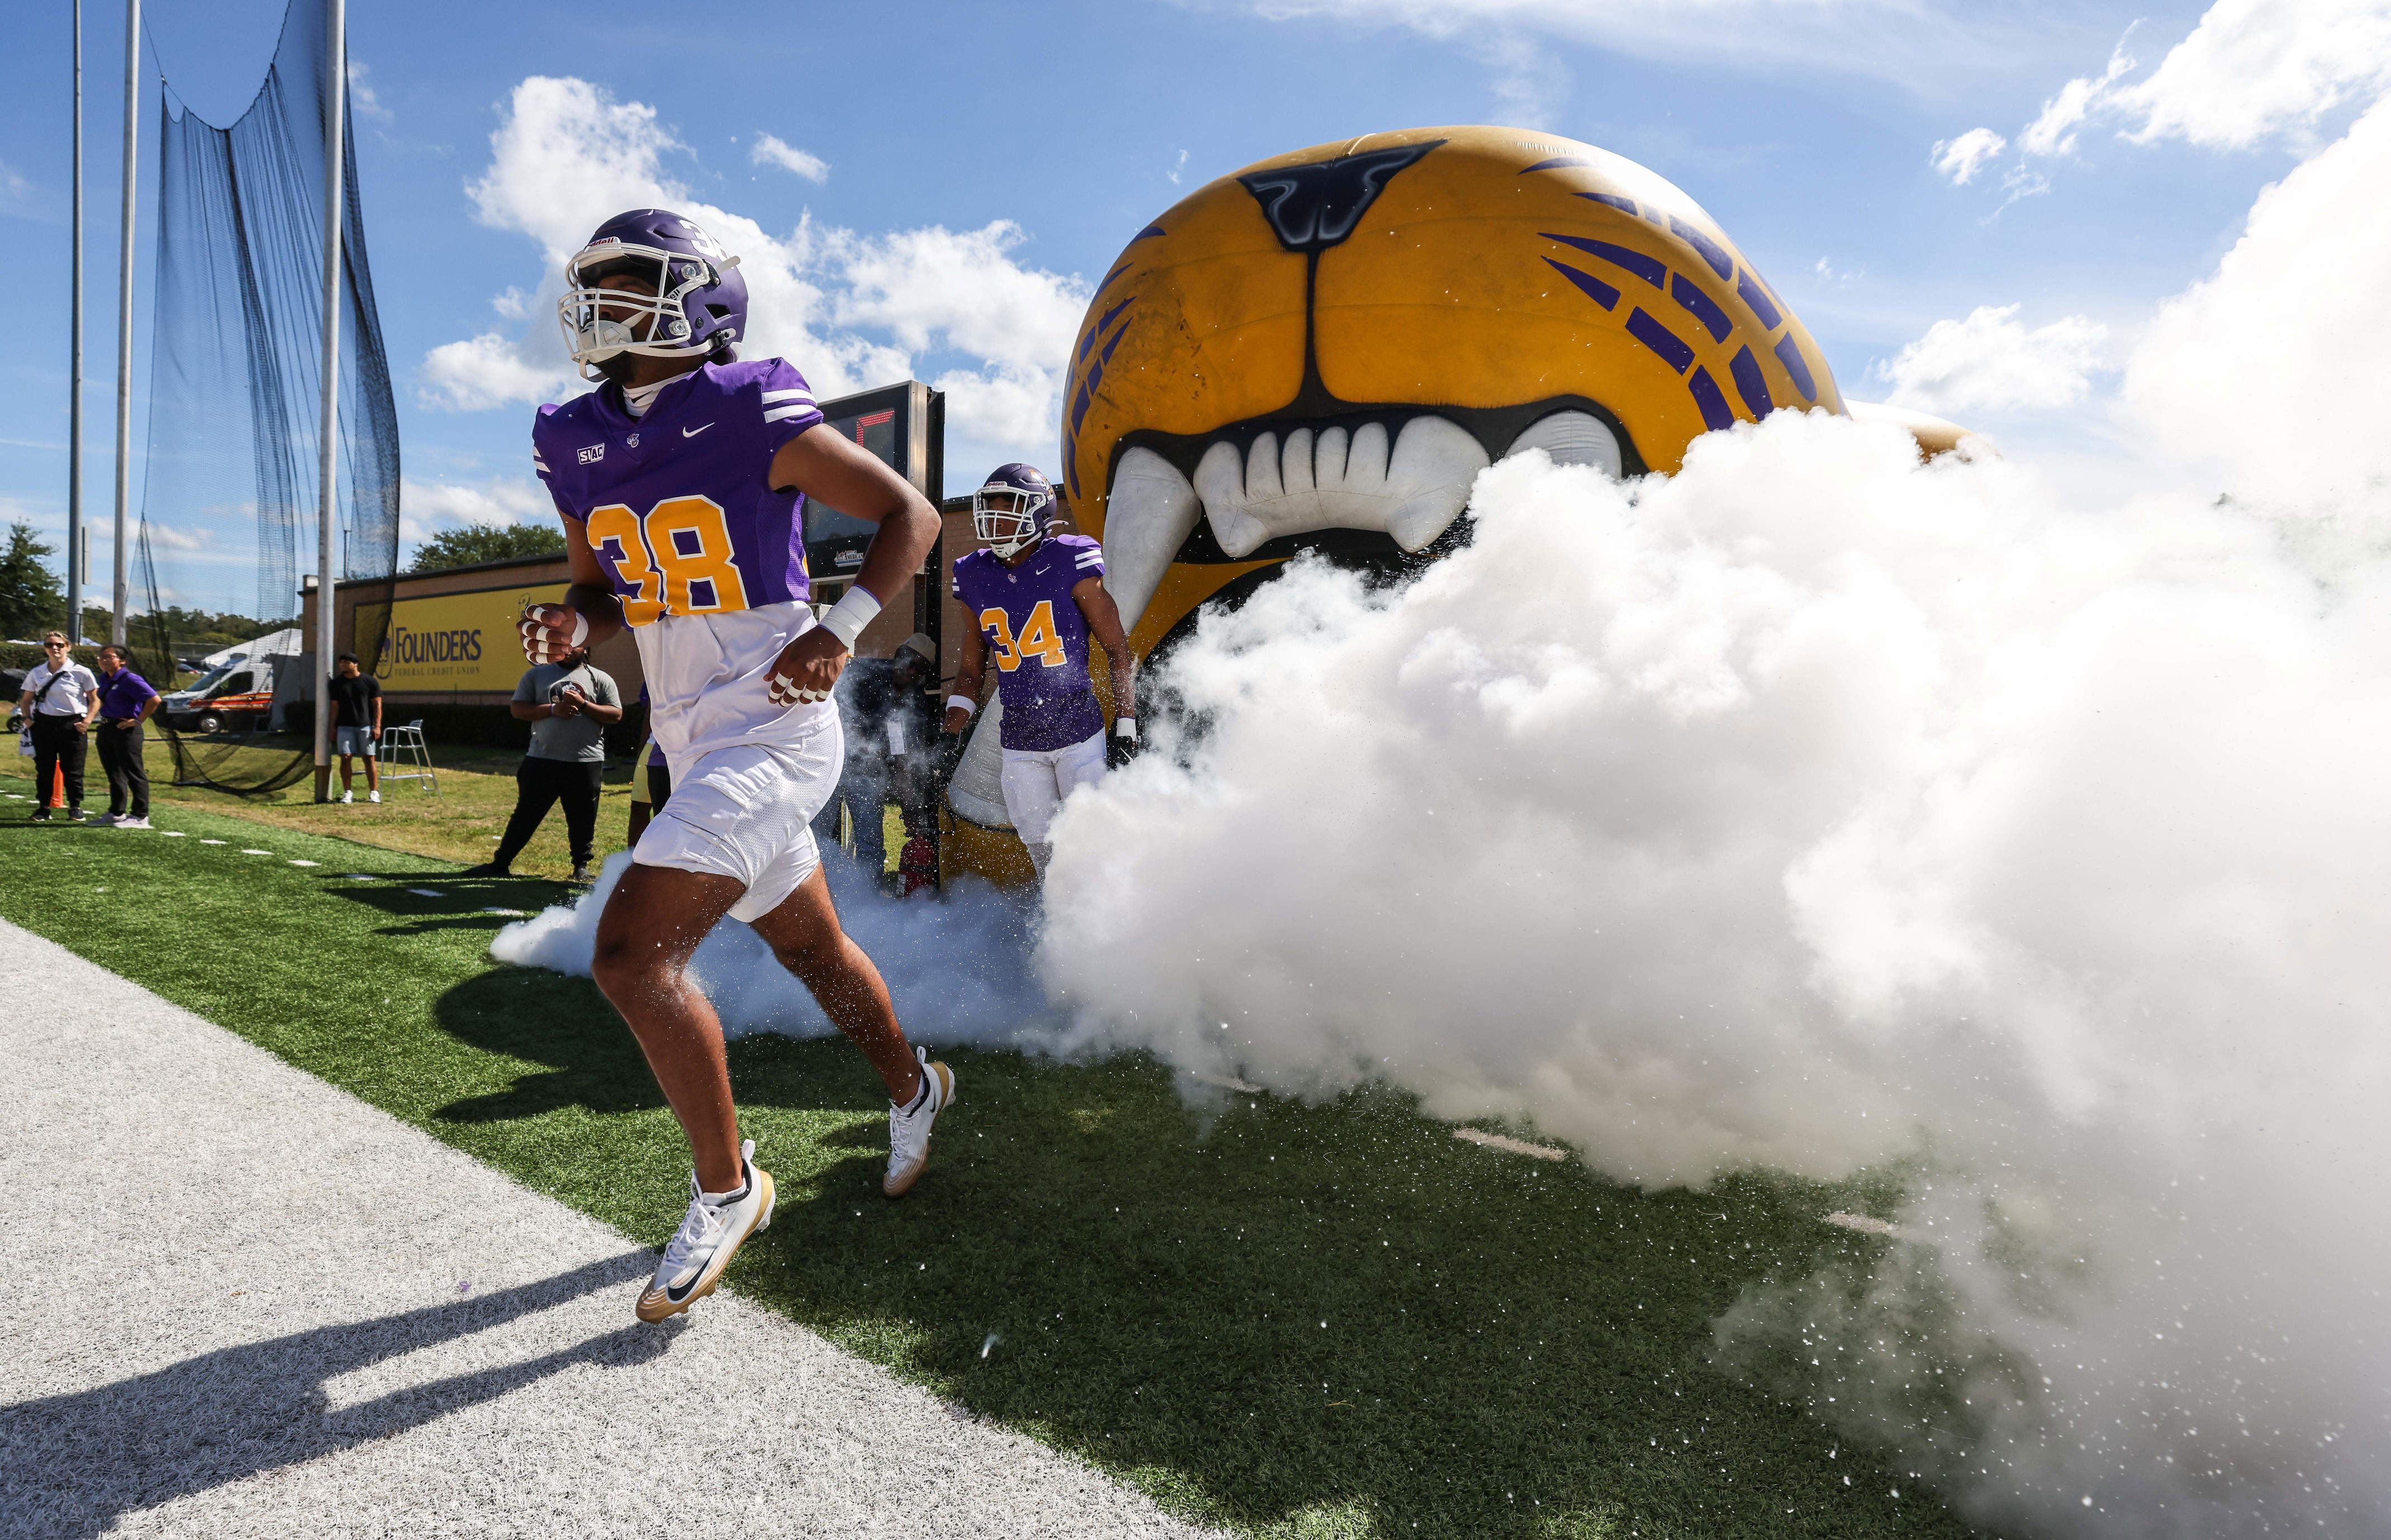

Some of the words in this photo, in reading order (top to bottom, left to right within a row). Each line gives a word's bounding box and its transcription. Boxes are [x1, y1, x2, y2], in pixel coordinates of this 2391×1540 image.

[579, 446, 603, 462] SIAC
[587, 494, 750, 628] 38
[394, 626, 482, 663] FOUNDERS
[980, 600, 1067, 672] 34
[394, 667, 424, 676] FEDERAL
[426, 666, 453, 676] CREDIT
[457, 666, 480, 675] UNION
